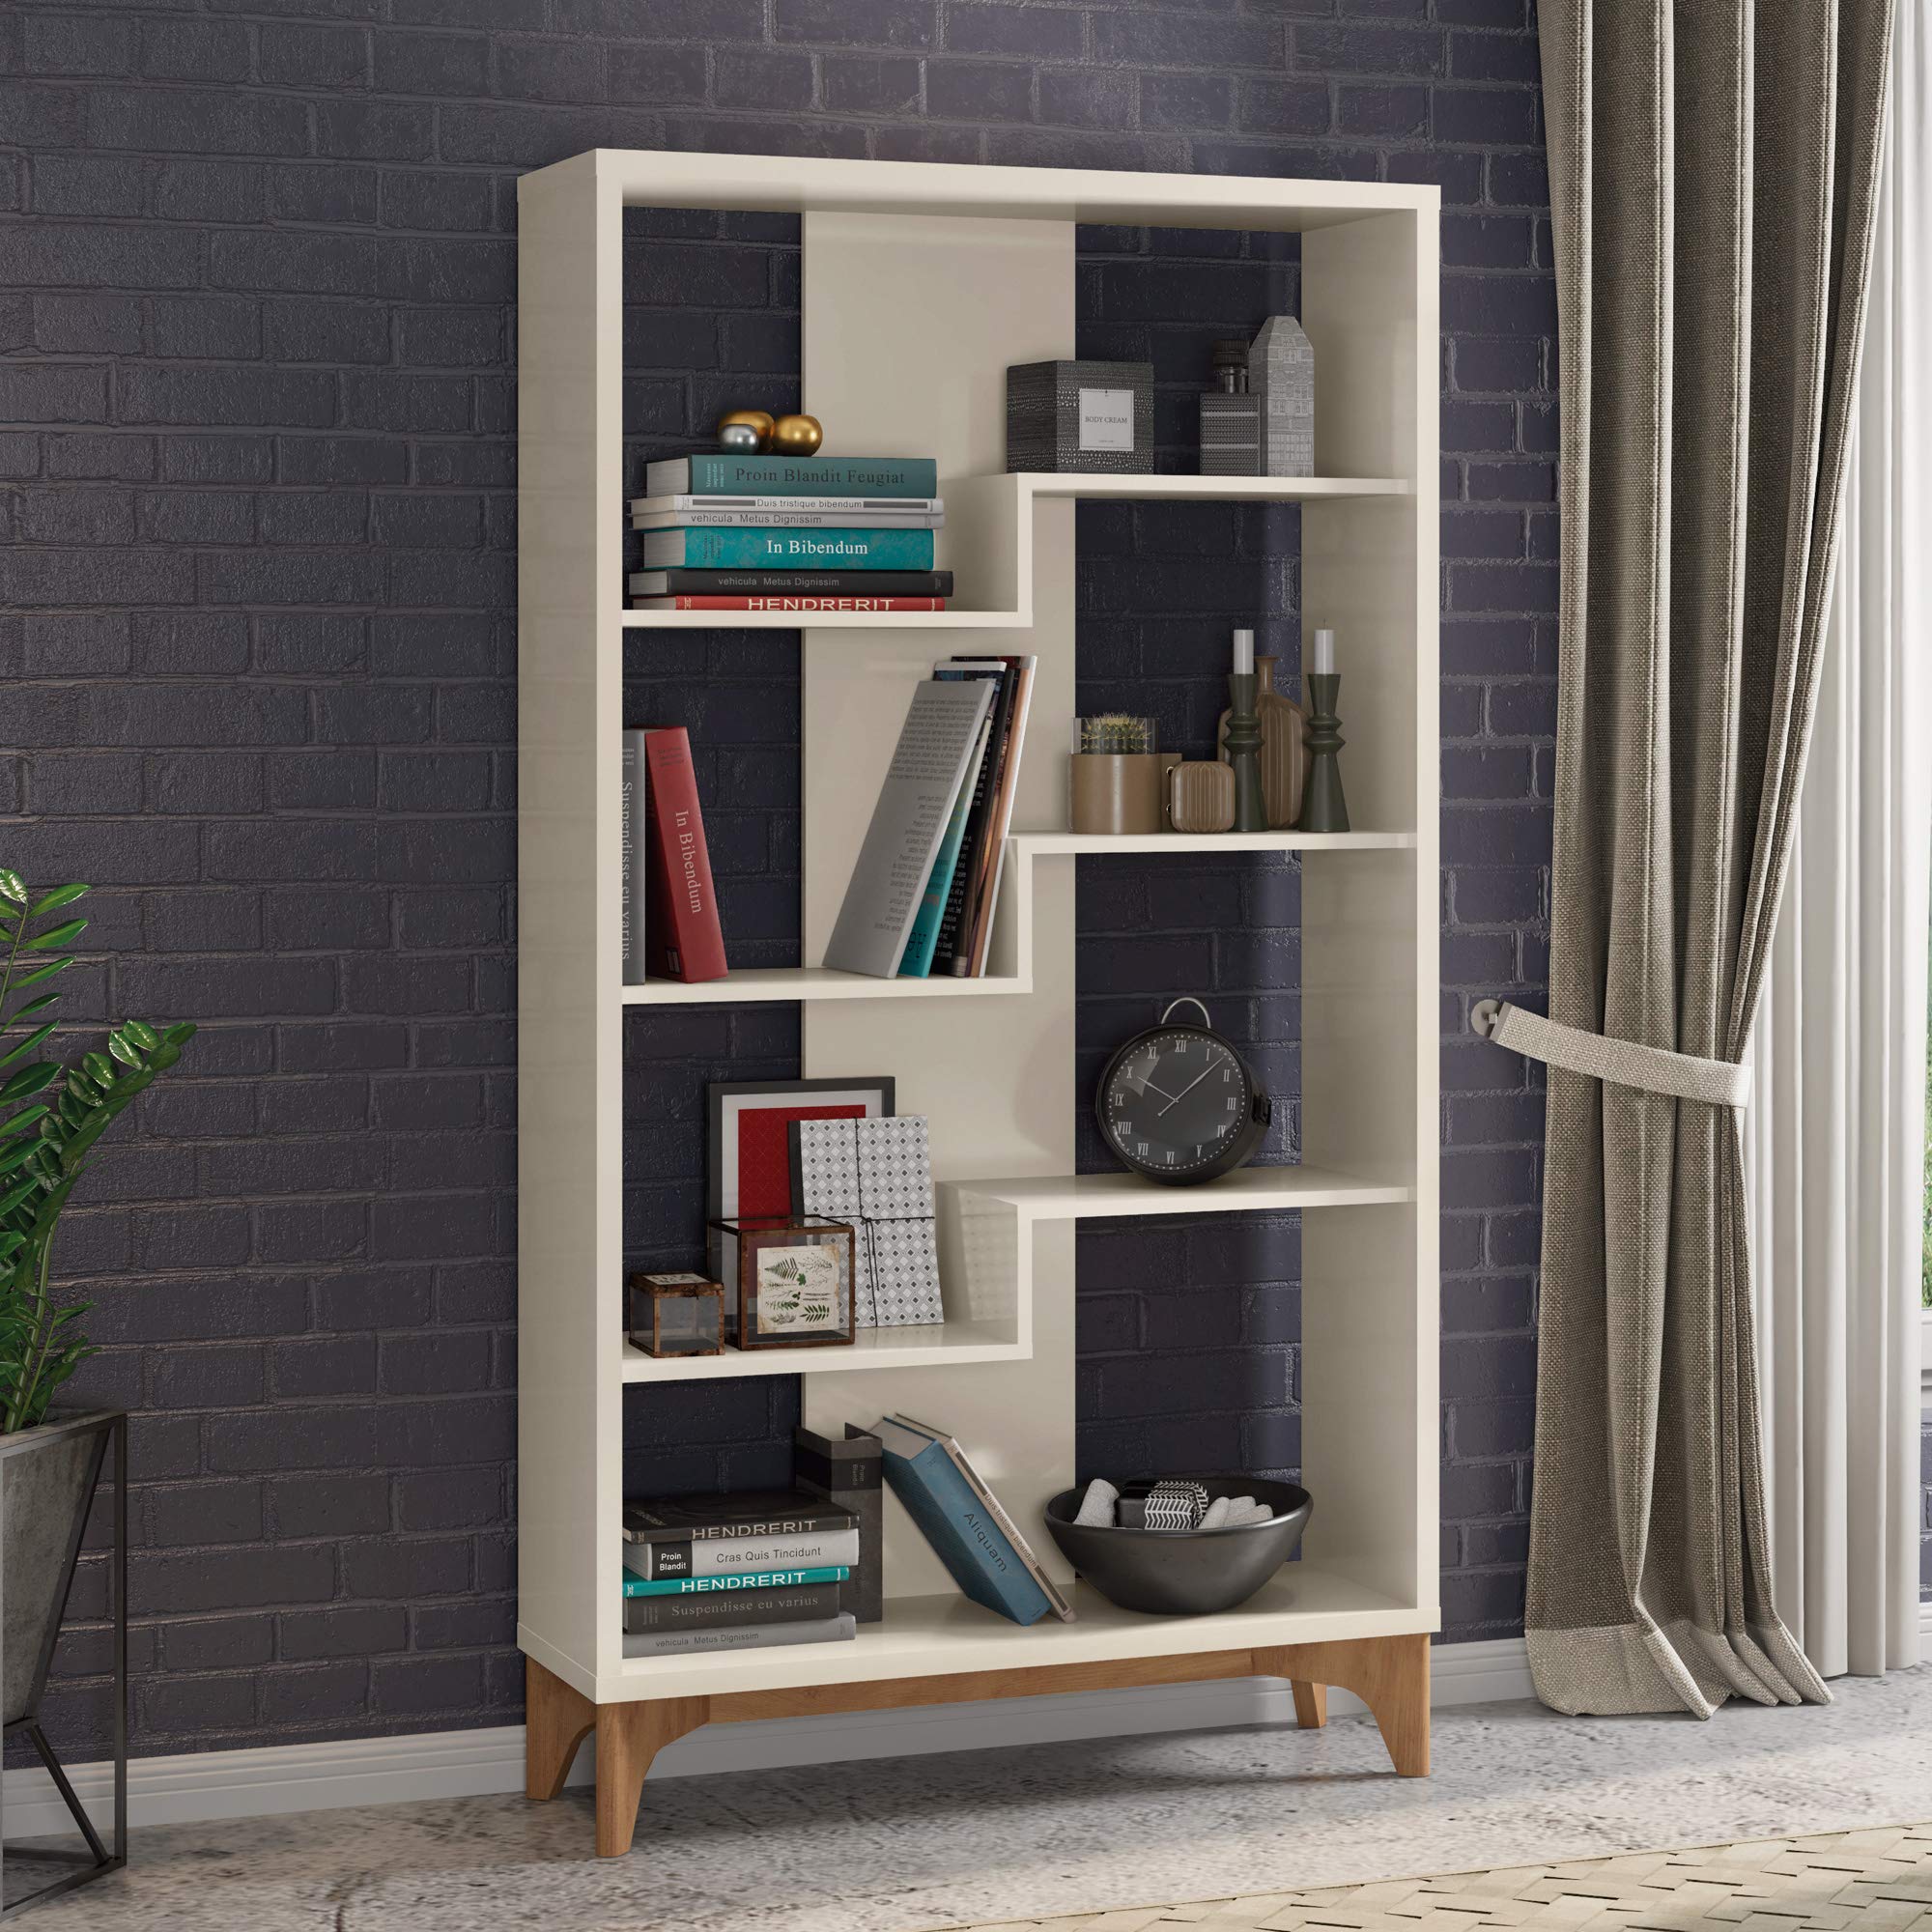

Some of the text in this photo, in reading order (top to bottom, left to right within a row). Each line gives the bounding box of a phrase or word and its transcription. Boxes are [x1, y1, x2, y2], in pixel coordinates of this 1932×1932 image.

[735, 468, 778, 482] Proin
[784, 469, 841, 483] Blandit
[848, 469, 905, 486] Feugiat
[756, 498, 862, 510] Duis tristique bibendum
[691, 513, 821, 526] vehicula Metus Dignissim
[767, 540, 868, 554] In Bibendum
[718, 577, 839, 587] vehicula Metus Dignissim
[748, 598, 895, 611] HENDRERIT
[675, 810, 702, 914] In Bibendum
[1175, 1040, 1186, 1052] XII
[1148, 1047, 1156, 1059] XI
[1206, 1049, 1209, 1061] I
[1126, 1066, 1132, 1078] X
[1224, 1069, 1229, 1082] II
[1115, 1094, 1124, 1106] IX
[1227, 1097, 1236, 1110] III
[1118, 1122, 1131, 1134] VIII
[1217, 1125, 1226, 1138] IV
[1138, 1143, 1149, 1155] VII
[1197, 1145, 1203, 1157] V
[1167, 1151, 1175, 1164] VI
[985, 1495, 997, 1510] Duis
[693, 1520, 817, 1540] HENDRERIT
[964, 1513, 1008, 1573] Aliquam
[661, 1552, 682, 1562] Proin
[717, 1547, 821, 1563] Cras Quis Tincidunt
[659, 1562, 686, 1572] Blandit
[682, 1573, 806, 1593] HENDRERIT
[672, 1602, 753, 1617] Suspendisse
[758, 1600, 774, 1609] eu
[779, 1596, 818, 1607] varius
[656, 1633, 759, 1647] vehicula Metus Dignissim
